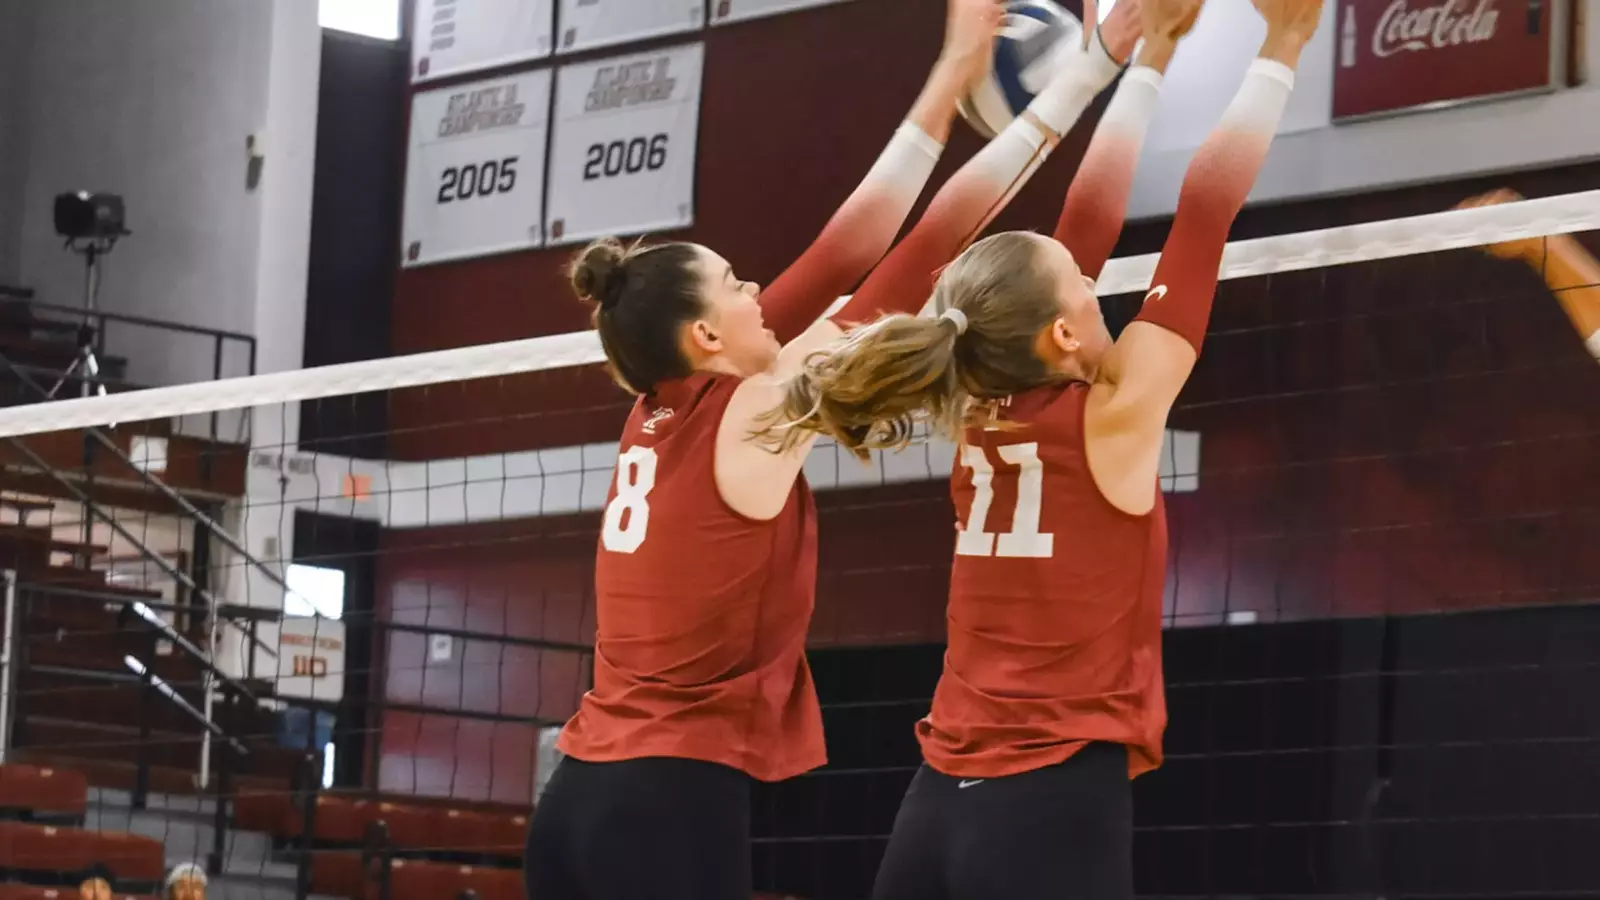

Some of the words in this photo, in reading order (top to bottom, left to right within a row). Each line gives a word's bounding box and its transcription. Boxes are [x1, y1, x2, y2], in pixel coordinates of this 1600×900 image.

[437, 157, 519, 204] 2005
[583, 133, 668, 182] 2006
[602, 445, 658, 554] 8
[956, 442, 1054, 558] 11
